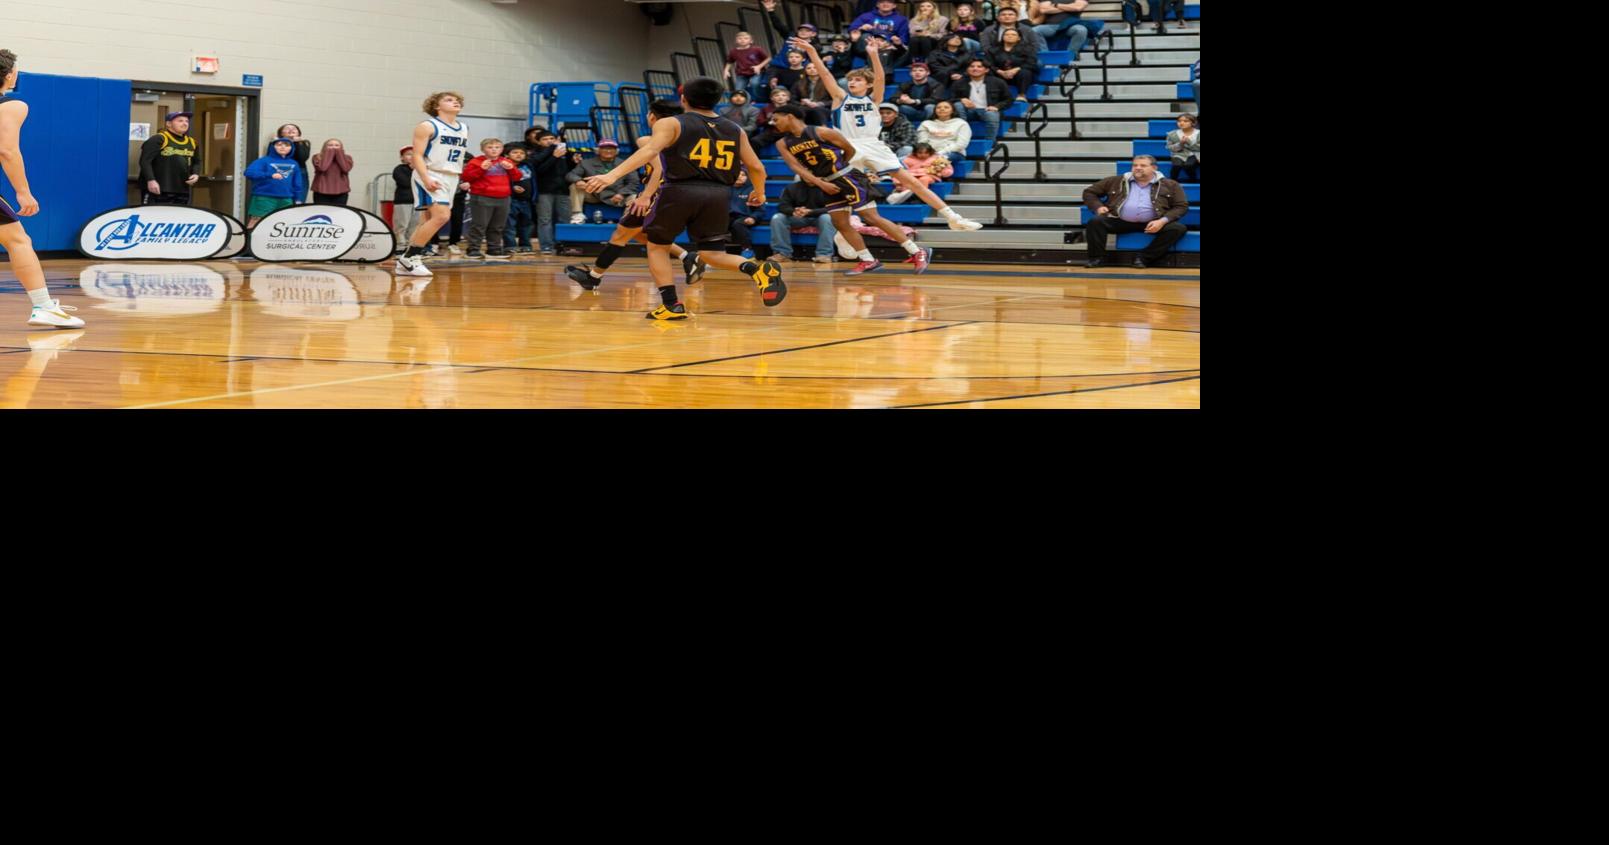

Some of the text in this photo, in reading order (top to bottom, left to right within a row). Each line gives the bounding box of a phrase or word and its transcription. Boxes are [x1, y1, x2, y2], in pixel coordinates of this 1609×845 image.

[855, 114, 866, 127] 3
[447, 149, 461, 162] 12
[689, 138, 736, 170] 45
[803, 150, 818, 166] 5
[95, 214, 216, 250] ALCANTAR
[269, 222, 345, 239] Sunrise
